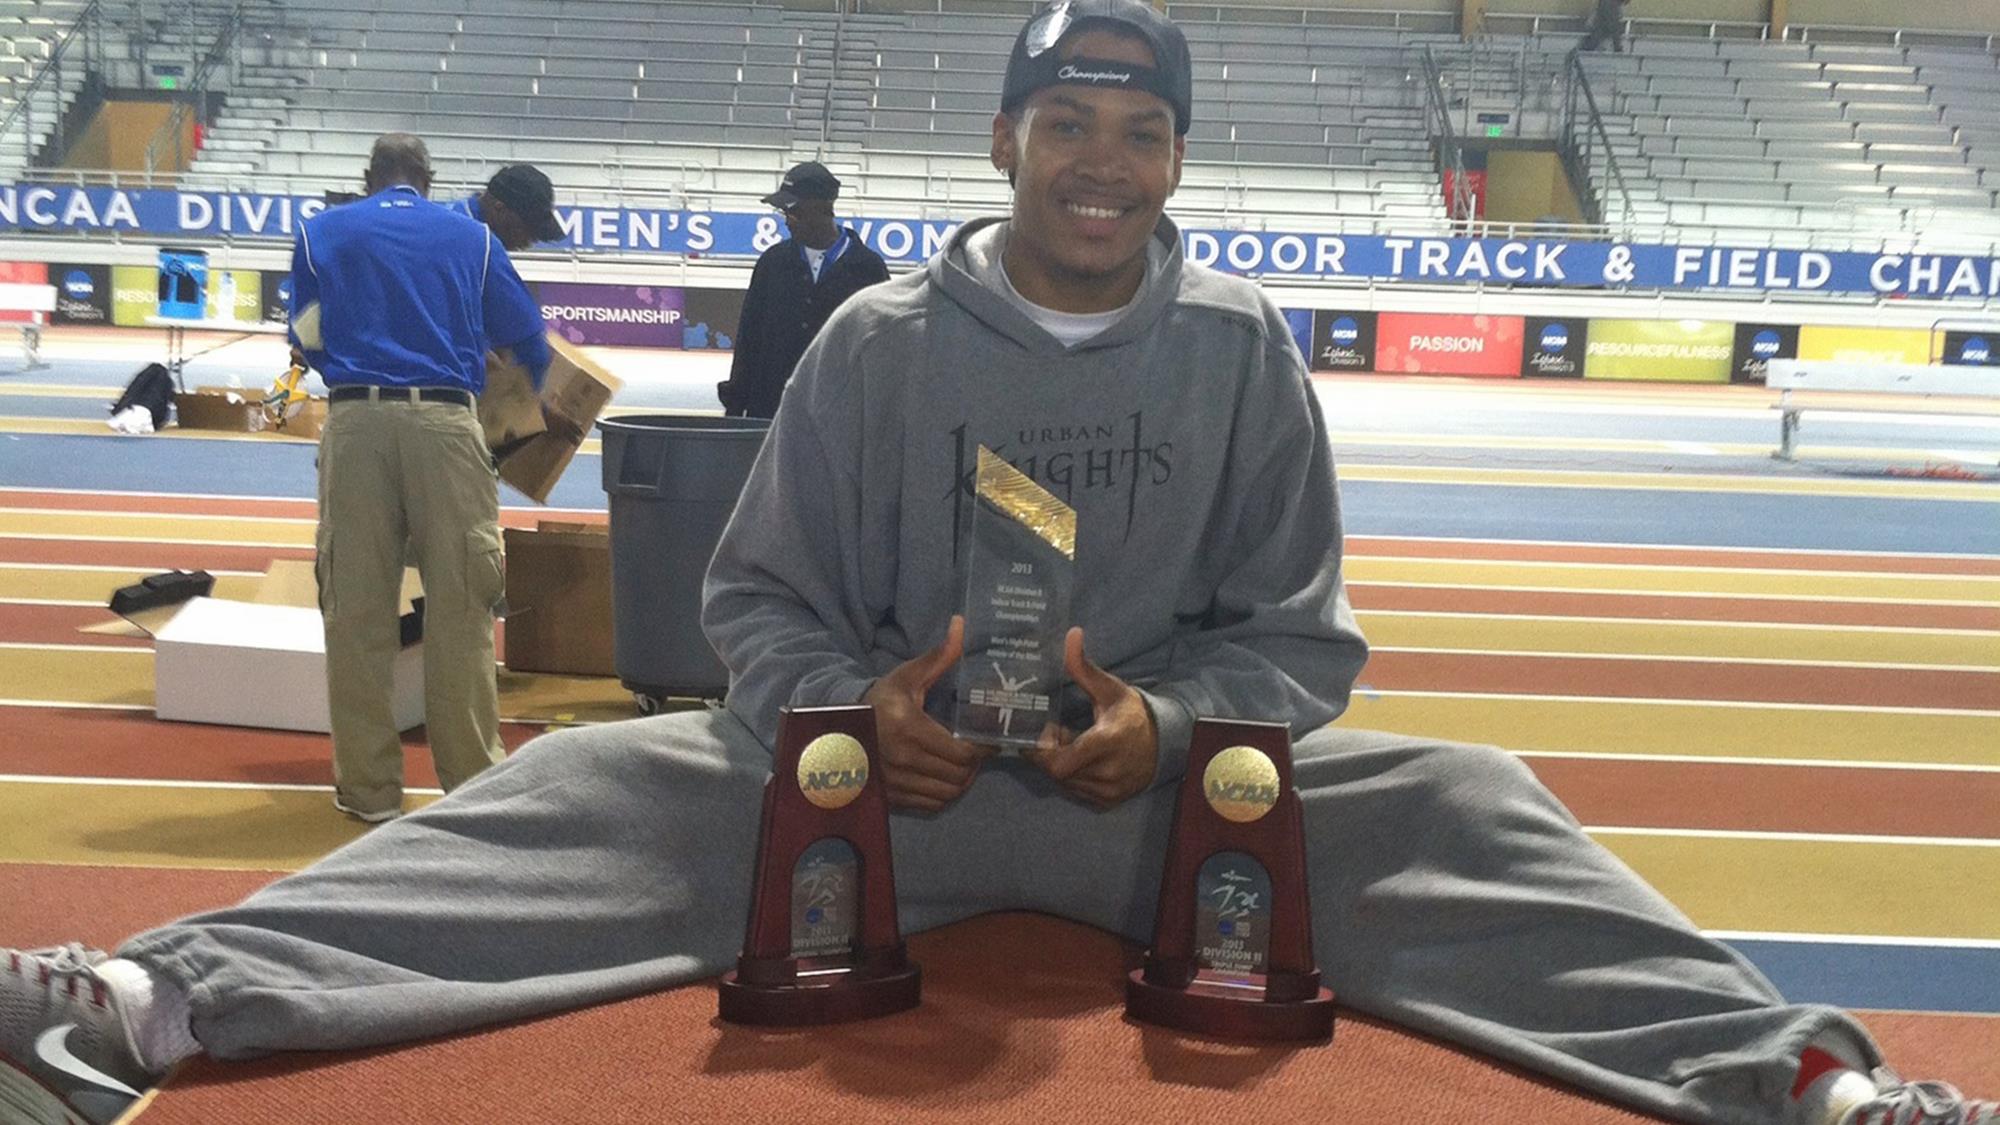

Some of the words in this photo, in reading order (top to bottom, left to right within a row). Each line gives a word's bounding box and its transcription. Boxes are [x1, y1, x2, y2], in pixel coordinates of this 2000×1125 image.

[0, 186, 140, 228] NCAA
[179, 194, 326, 234] DIVIS
[553, 209, 714, 250] MEN'S
[752, 216, 783, 252] &
[1182, 232, 1346, 273] DOOR
[1385, 239, 1568, 281] TRACK
[1603, 245, 1636, 282] &
[1674, 247, 1832, 290] FIELD
[541, 305, 680, 324] SPORTSMANSHIP
[1409, 335, 1484, 352] PASSION
[1588, 342, 1730, 360] RESOURCEFULNESS
[1019, 425, 1114, 445] URBAN
[943, 410, 1174, 568] KIGHTS
[1011, 562, 1033, 575] 2013
[804, 766, 866, 791] NCAA
[1203, 946, 1252, 961] DIVISION
